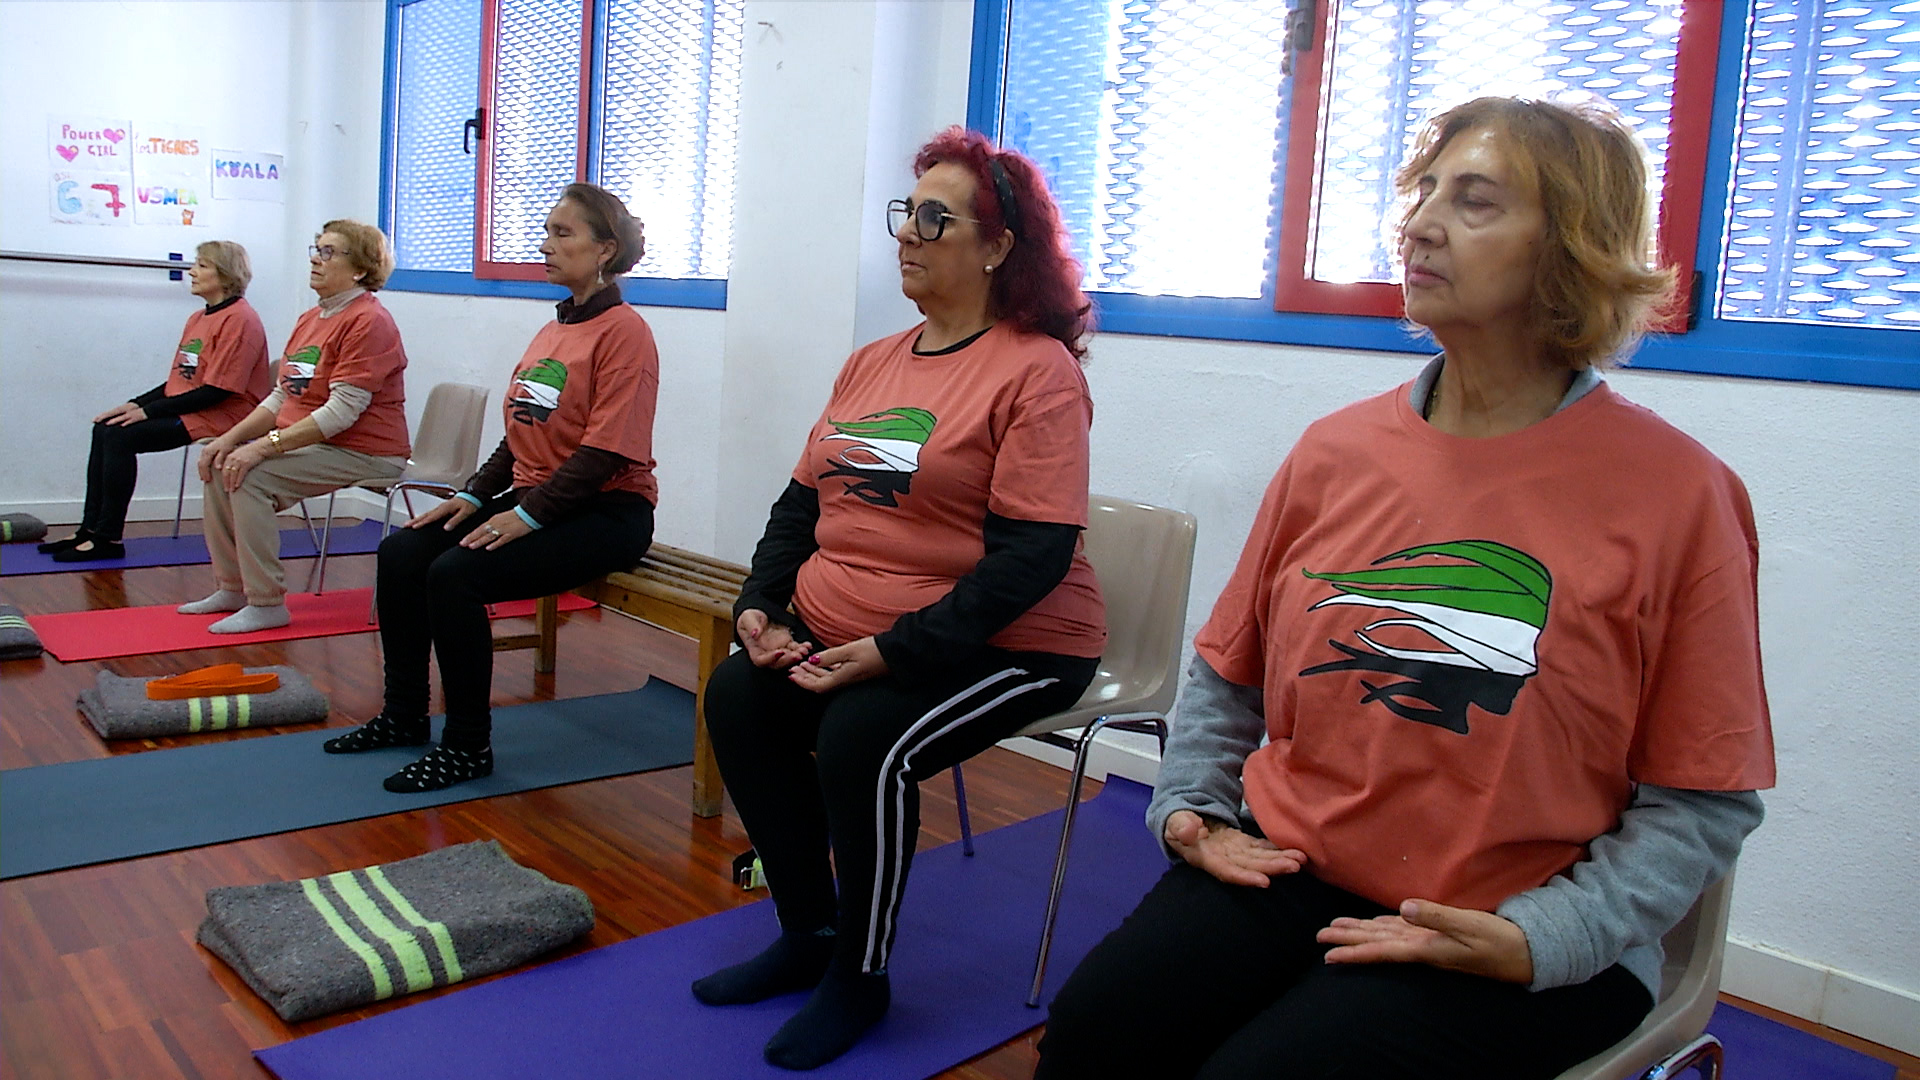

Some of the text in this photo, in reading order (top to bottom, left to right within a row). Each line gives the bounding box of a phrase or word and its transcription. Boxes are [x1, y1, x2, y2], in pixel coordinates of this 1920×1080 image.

[87, 144, 118, 157] GIRL
[215, 158, 279, 180] KOALA
[57, 180, 82, 214] 6
[90, 183, 126, 218] 7
